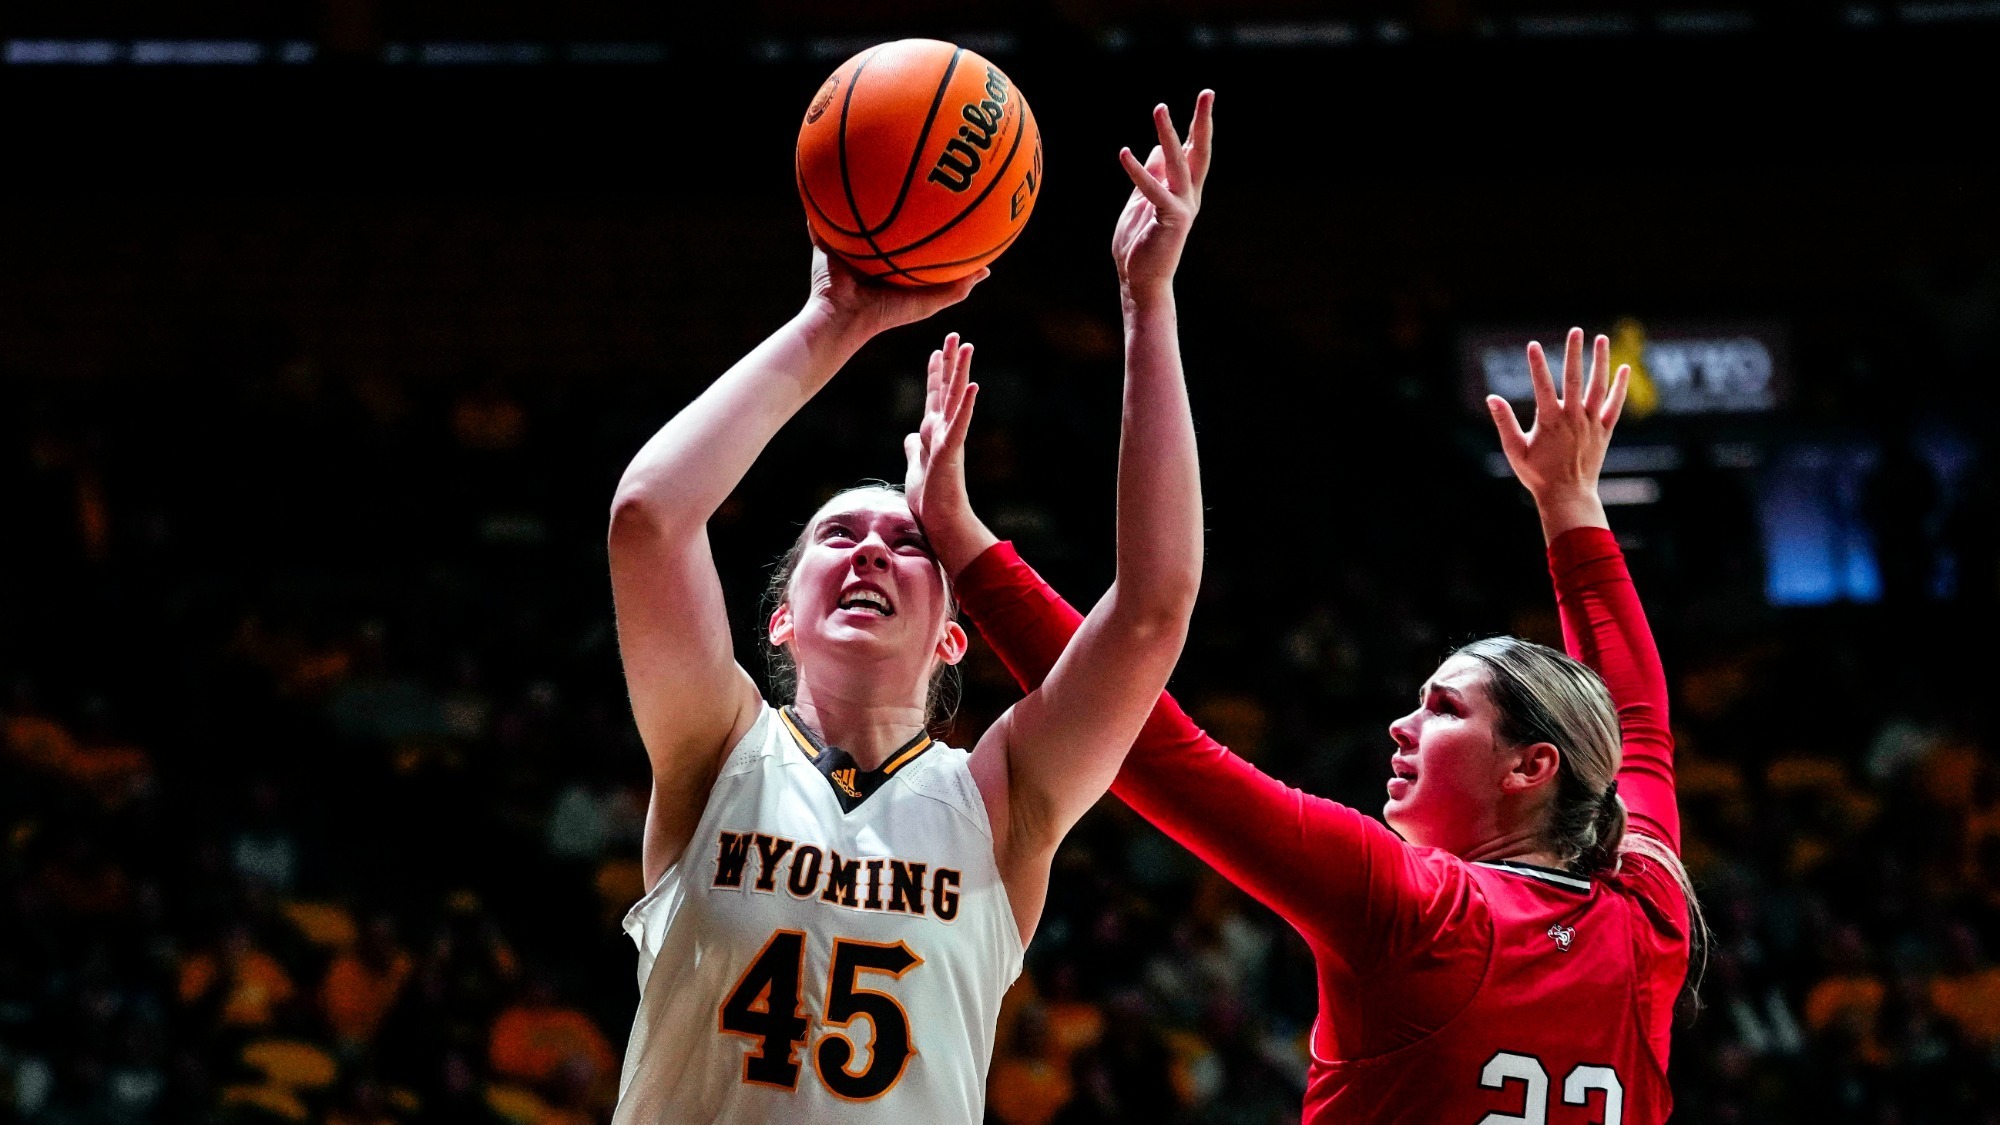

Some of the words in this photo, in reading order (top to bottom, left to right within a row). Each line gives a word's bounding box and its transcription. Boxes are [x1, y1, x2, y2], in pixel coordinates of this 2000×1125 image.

[926, 64, 1010, 193] Wilson
[831, 771, 862, 798] adidas
[711, 830, 962, 924] WYOMING
[718, 928, 925, 1103] 45
